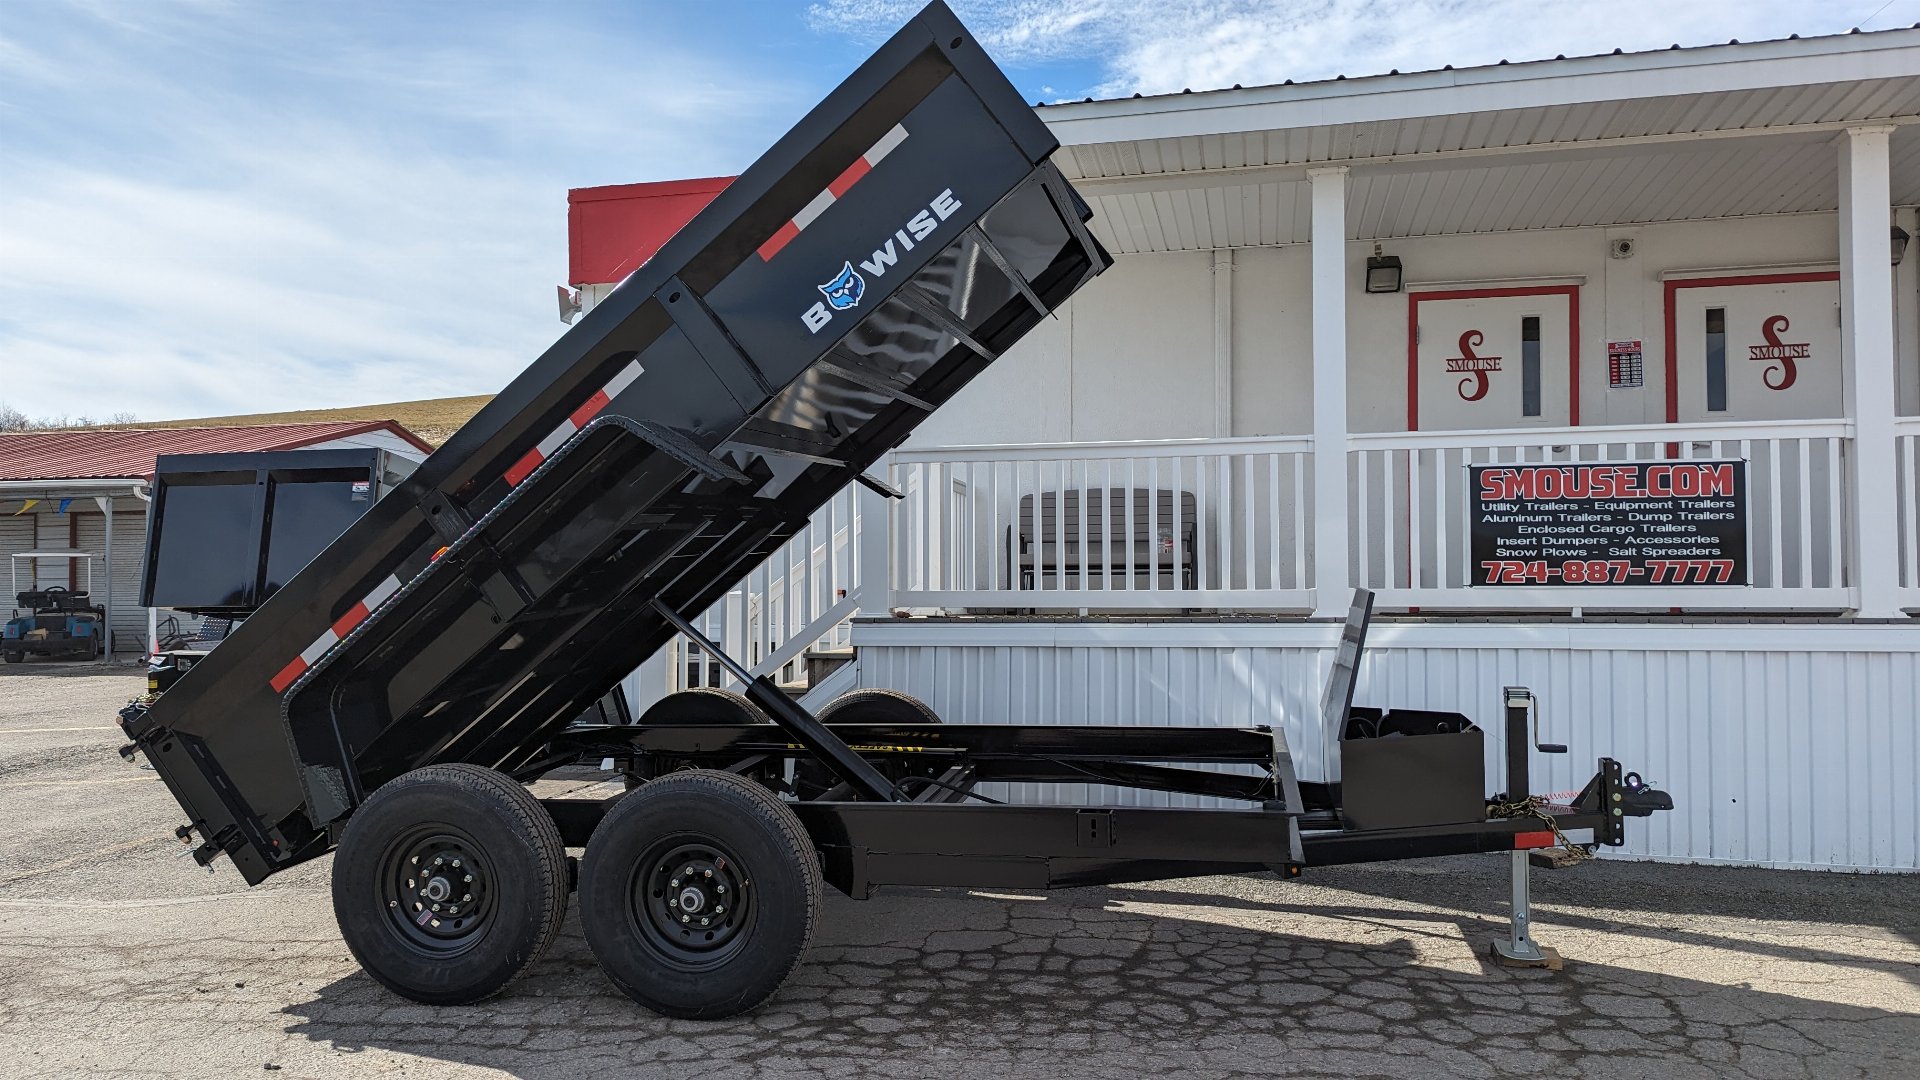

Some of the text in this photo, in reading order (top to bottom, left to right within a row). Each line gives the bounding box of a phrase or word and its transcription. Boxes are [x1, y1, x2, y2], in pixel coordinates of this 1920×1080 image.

[1750, 344, 1810, 360] SMOUSE
[1446, 358, 1501, 371] SMOUSE
[1480, 464, 1734, 500] SMOUSE.COM
[1482, 502, 1519, 512] Utility
[1524, 502, 1578, 510] Trailers
[1595, 501, 1672, 511] Equipment
[1678, 500, 1735, 508] Trailers
[1482, 514, 1552, 522] Aluminum
[1557, 513, 1611, 522] Trailers
[1628, 512, 1672, 522] Dump
[1678, 512, 1734, 520] Trailers
[1518, 524, 1696, 534] Enclosed Cargo Trailers
[1497, 537, 1537, 545] Insert
[1542, 536, 1608, 546] Dumpers
[1625, 536, 1719, 544] Accessories
[1496, 548, 1539, 556] Snow
[1542, 548, 1587, 556] Plows
[1609, 547, 1638, 556] Salt
[1642, 547, 1720, 557] Spreaders
[1482, 560, 1734, 584] 724-887-7777
